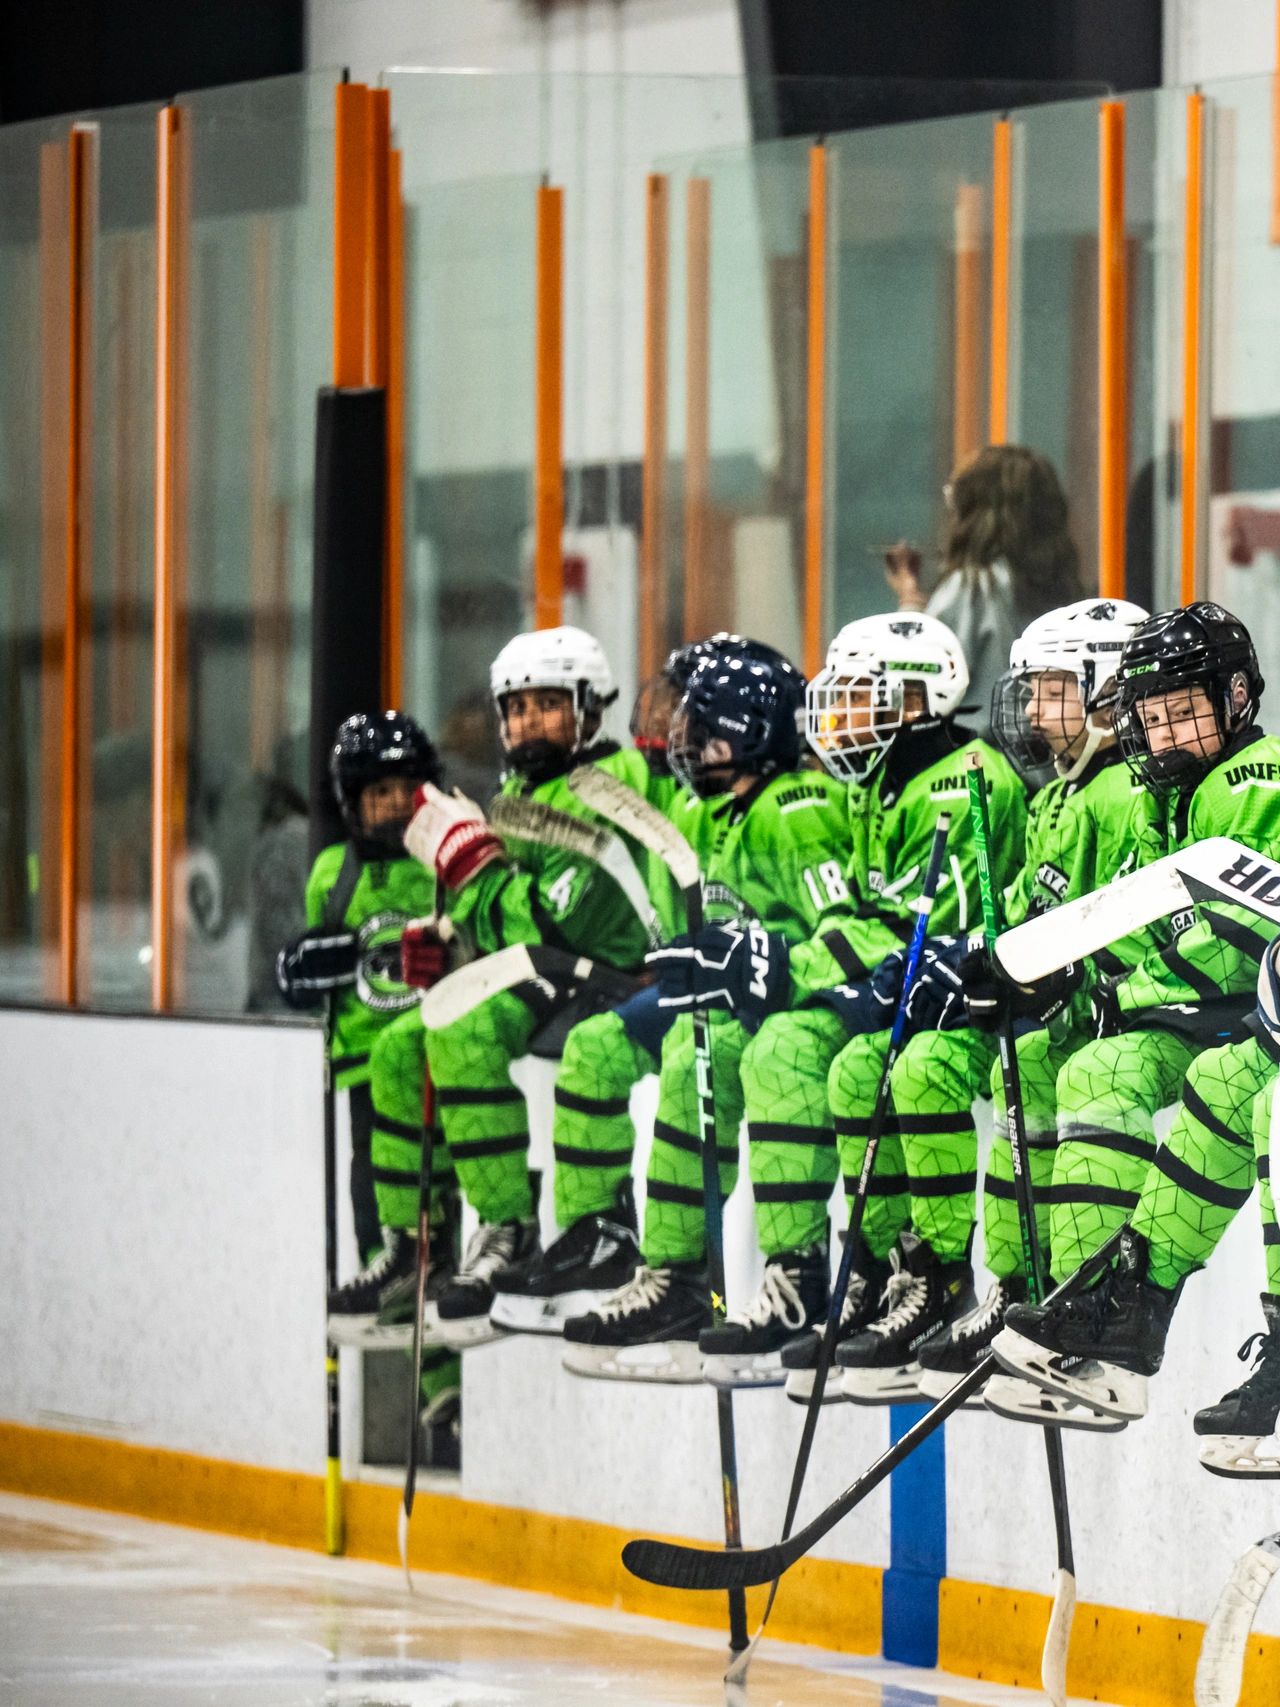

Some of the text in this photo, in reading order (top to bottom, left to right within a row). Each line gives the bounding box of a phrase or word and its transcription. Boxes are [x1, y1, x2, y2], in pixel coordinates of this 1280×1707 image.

[1129, 664, 1156, 679] CCM
[931, 774, 993, 797] UNIY
[803, 860, 848, 910] 18
[1007, 1117, 1022, 1176] BAUER
